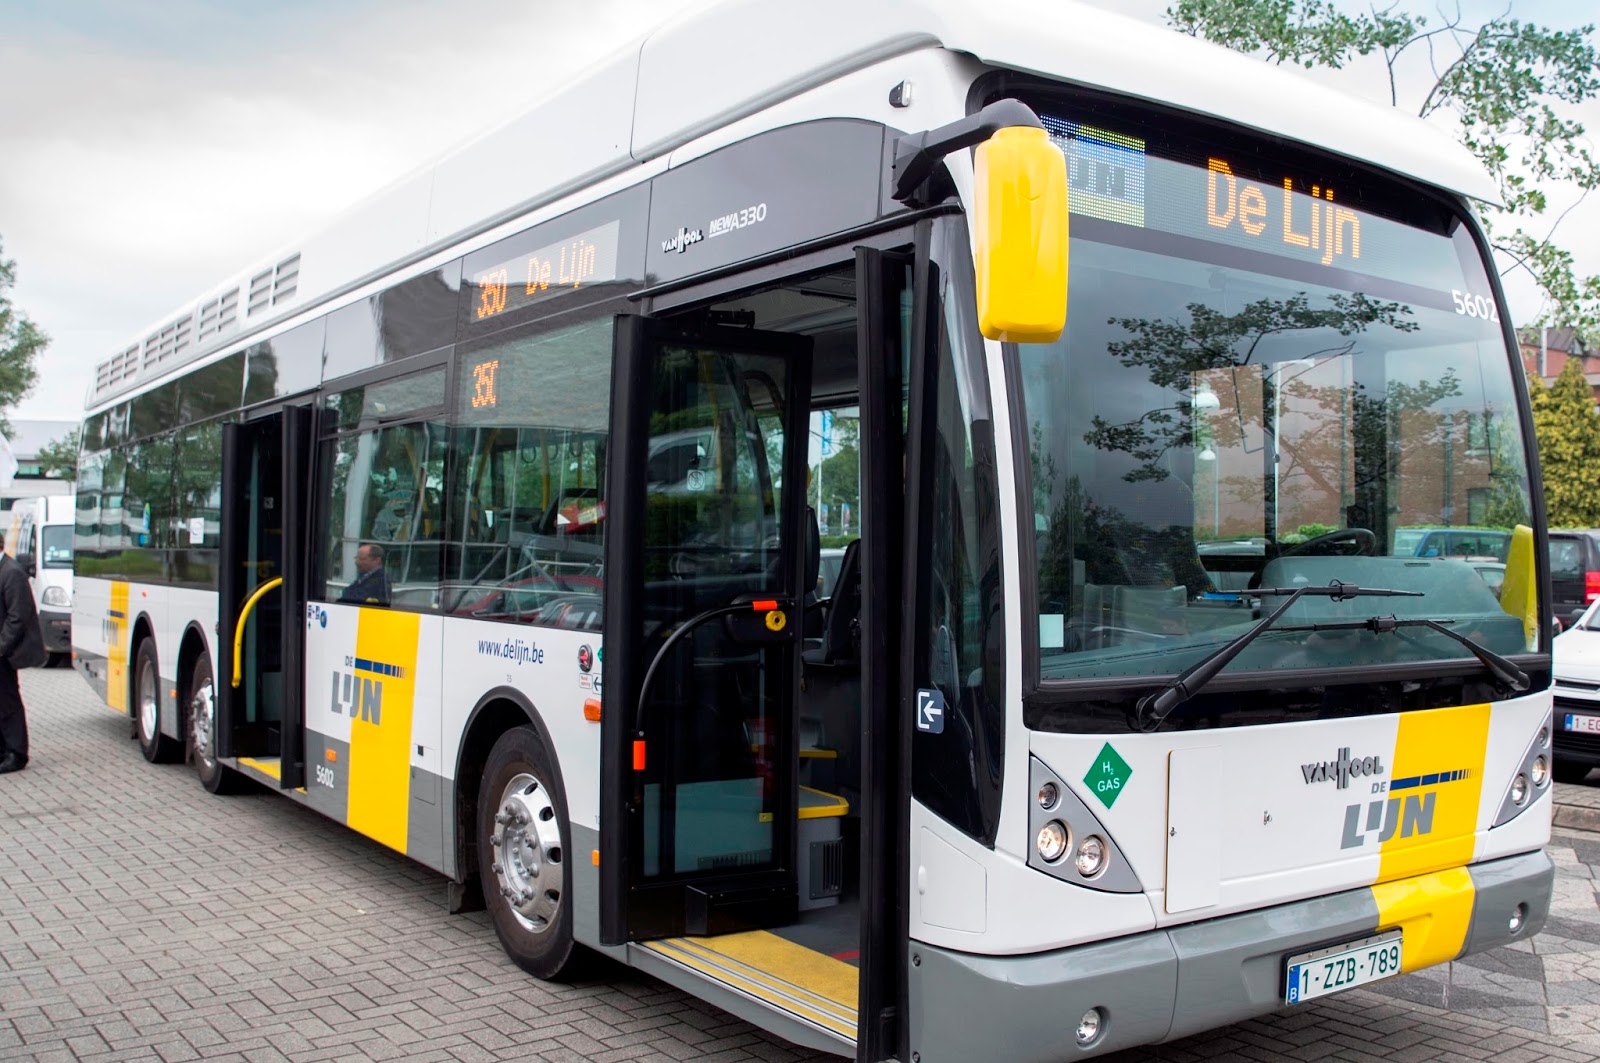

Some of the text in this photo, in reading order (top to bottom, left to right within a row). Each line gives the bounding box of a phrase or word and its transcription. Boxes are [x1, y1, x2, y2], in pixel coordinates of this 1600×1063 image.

[1208, 156, 1360, 266] De Lijn
[477, 239, 596, 318] 350 De Lijn
[1451, 289, 1500, 323] 5602
[345, 655, 354, 668] DE
[478, 638, 544, 666] www.delijn.be
[331, 671, 382, 726] LIJN
[316, 763, 335, 788] 5602
[1097, 777, 1120, 792] GAS
[1371, 781, 1386, 795] DE
[1340, 792, 1437, 850] LIJN
[1289, 987, 1298, 1000] B
